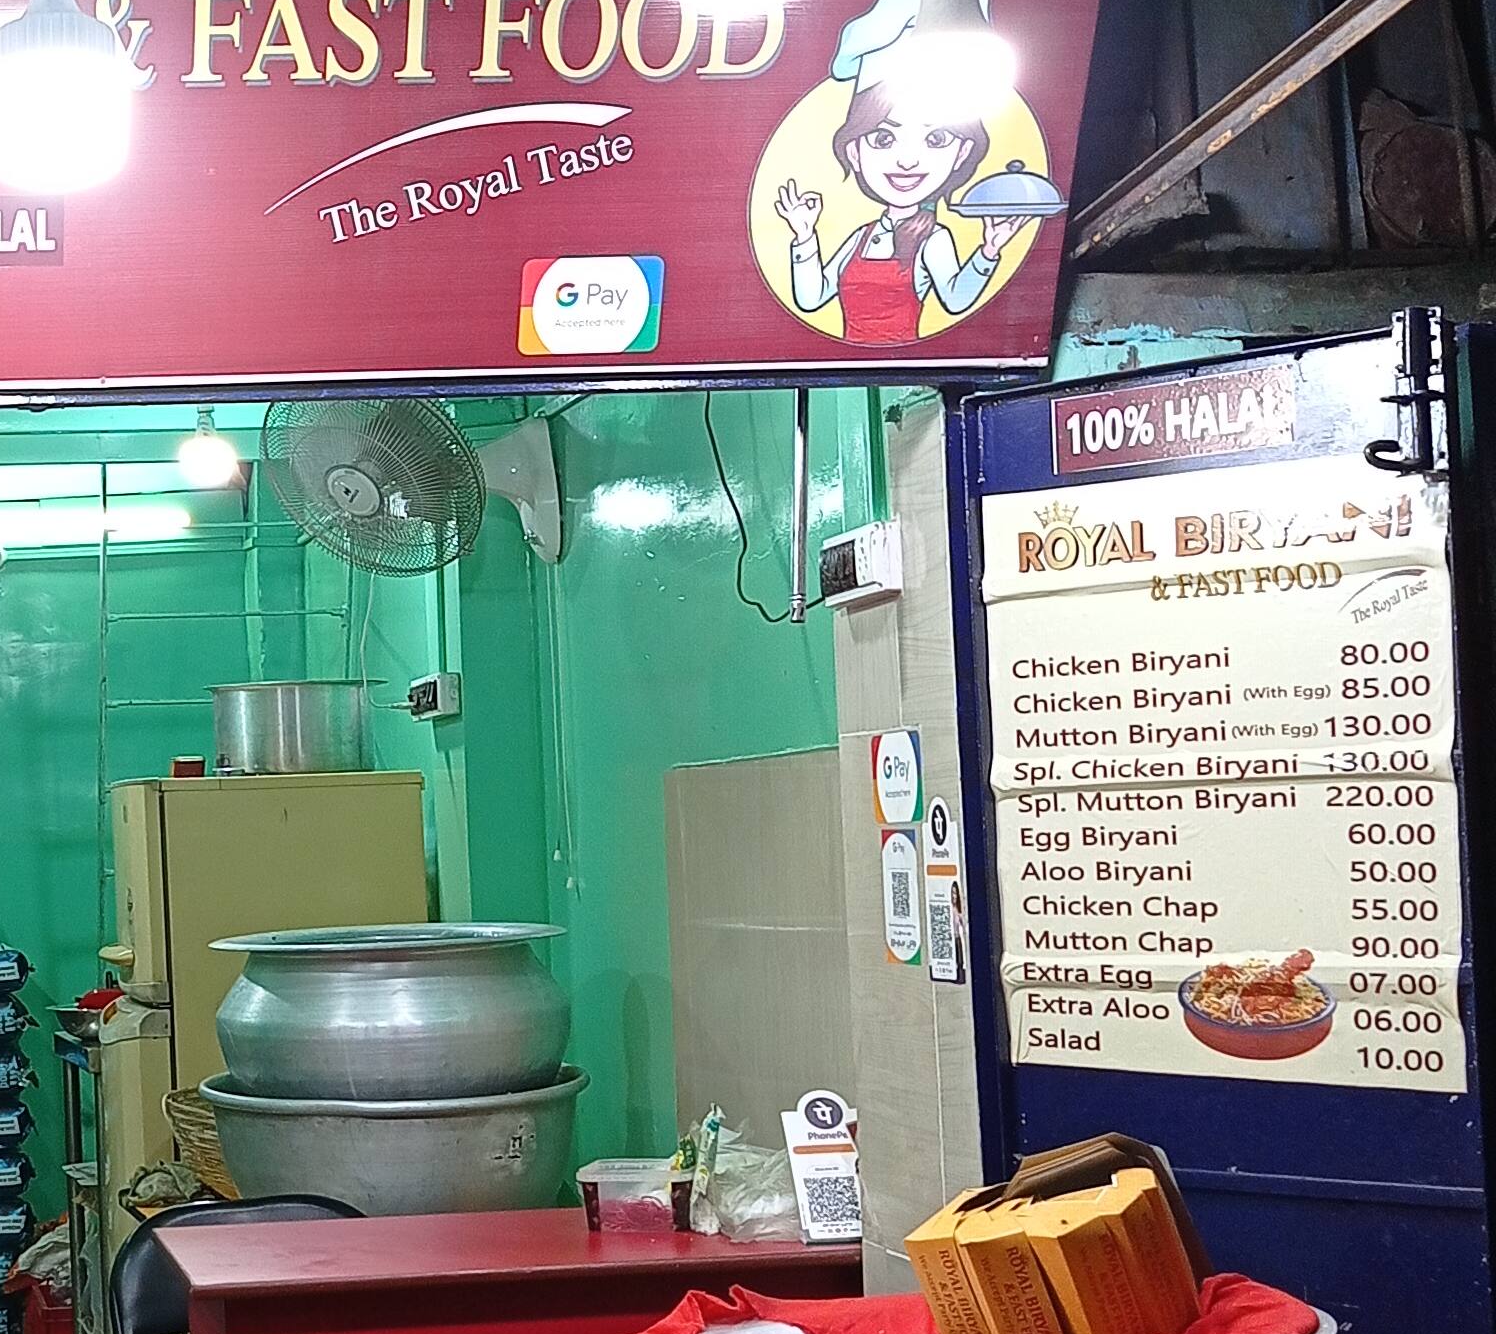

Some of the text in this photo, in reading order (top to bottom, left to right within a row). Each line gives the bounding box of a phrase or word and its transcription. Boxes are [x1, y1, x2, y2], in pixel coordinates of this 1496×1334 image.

[318, 126, 636, 247] The Royal Taste
[555, 282, 629, 310] G Pay
[1065, 403, 1155, 456] 100%
[1017, 519, 1157, 574] ROYAL
[1150, 561, 1345, 602] & FAST FOOD
[1371, 590, 1403, 619] Royal
[1012, 640, 1430, 680] Chicken Biryani 80.00
[1013, 674, 1432, 715] Chicken Biryani (With Egg) 85.00
[1015, 712, 1433, 751] Mutton Biryani (With Egg) 130.00
[894, 756, 911, 783] Pay
[1013, 748, 1430, 785] Spl. Chicken Biryani 130.00
[1017, 785, 1435, 818] Spl. Mutton Biryani 220.00
[1019, 822, 1437, 852] Egg Biryani 60.00
[1021, 859, 1438, 888] Aloo Biryani 50.00
[1022, 895, 1439, 923] Chicken Chap 55.00
[1024, 929, 1440, 961] Mutton Chap 90.00
[1022, 961, 1438, 997] Extra Egg 07.00
[1026, 993, 1443, 1035] Extra Aloo 06.00
[1027, 1027, 1445, 1074] Salad 10.00
[807, 1130, 849, 1142] PhonePe
[1006, 1246, 1034, 1295] ROYAL
